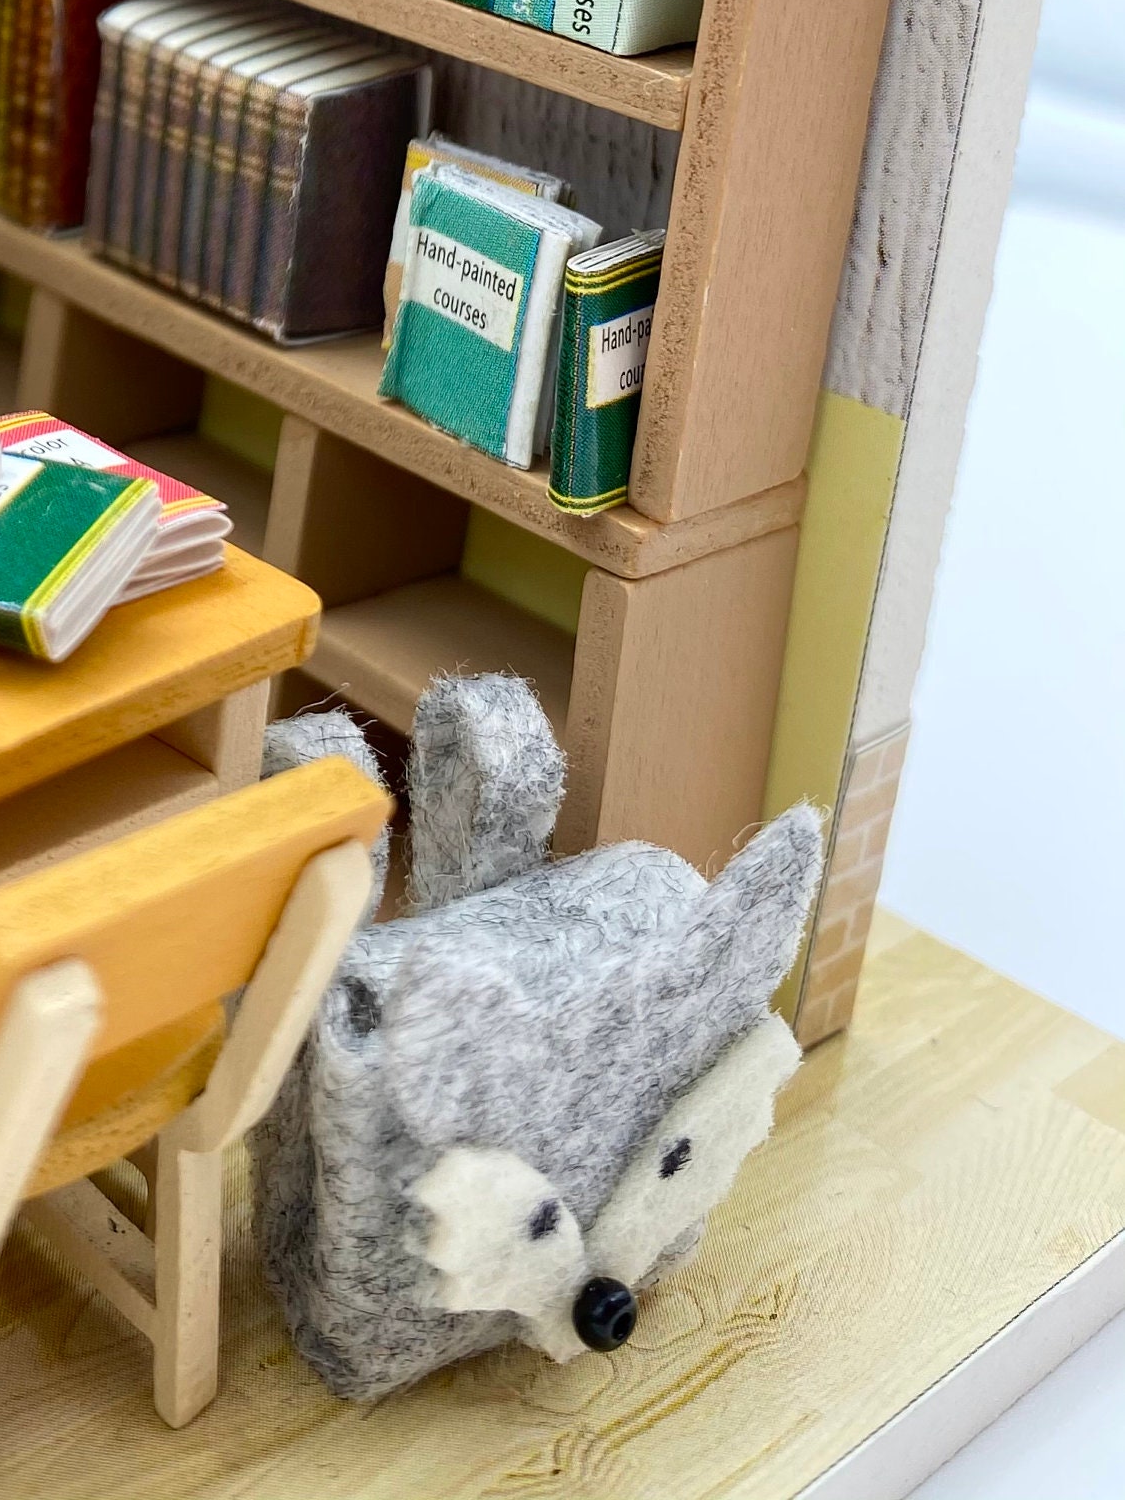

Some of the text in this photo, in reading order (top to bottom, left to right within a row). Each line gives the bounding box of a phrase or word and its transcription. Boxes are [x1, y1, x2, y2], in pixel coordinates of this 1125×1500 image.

[416, 232, 517, 303] Hand-painted
[433, 285, 487, 331] courses
[602, 316, 652, 353] Hand-pa
[620, 364, 644, 391] cour
[21, 438, 68, 458] color
